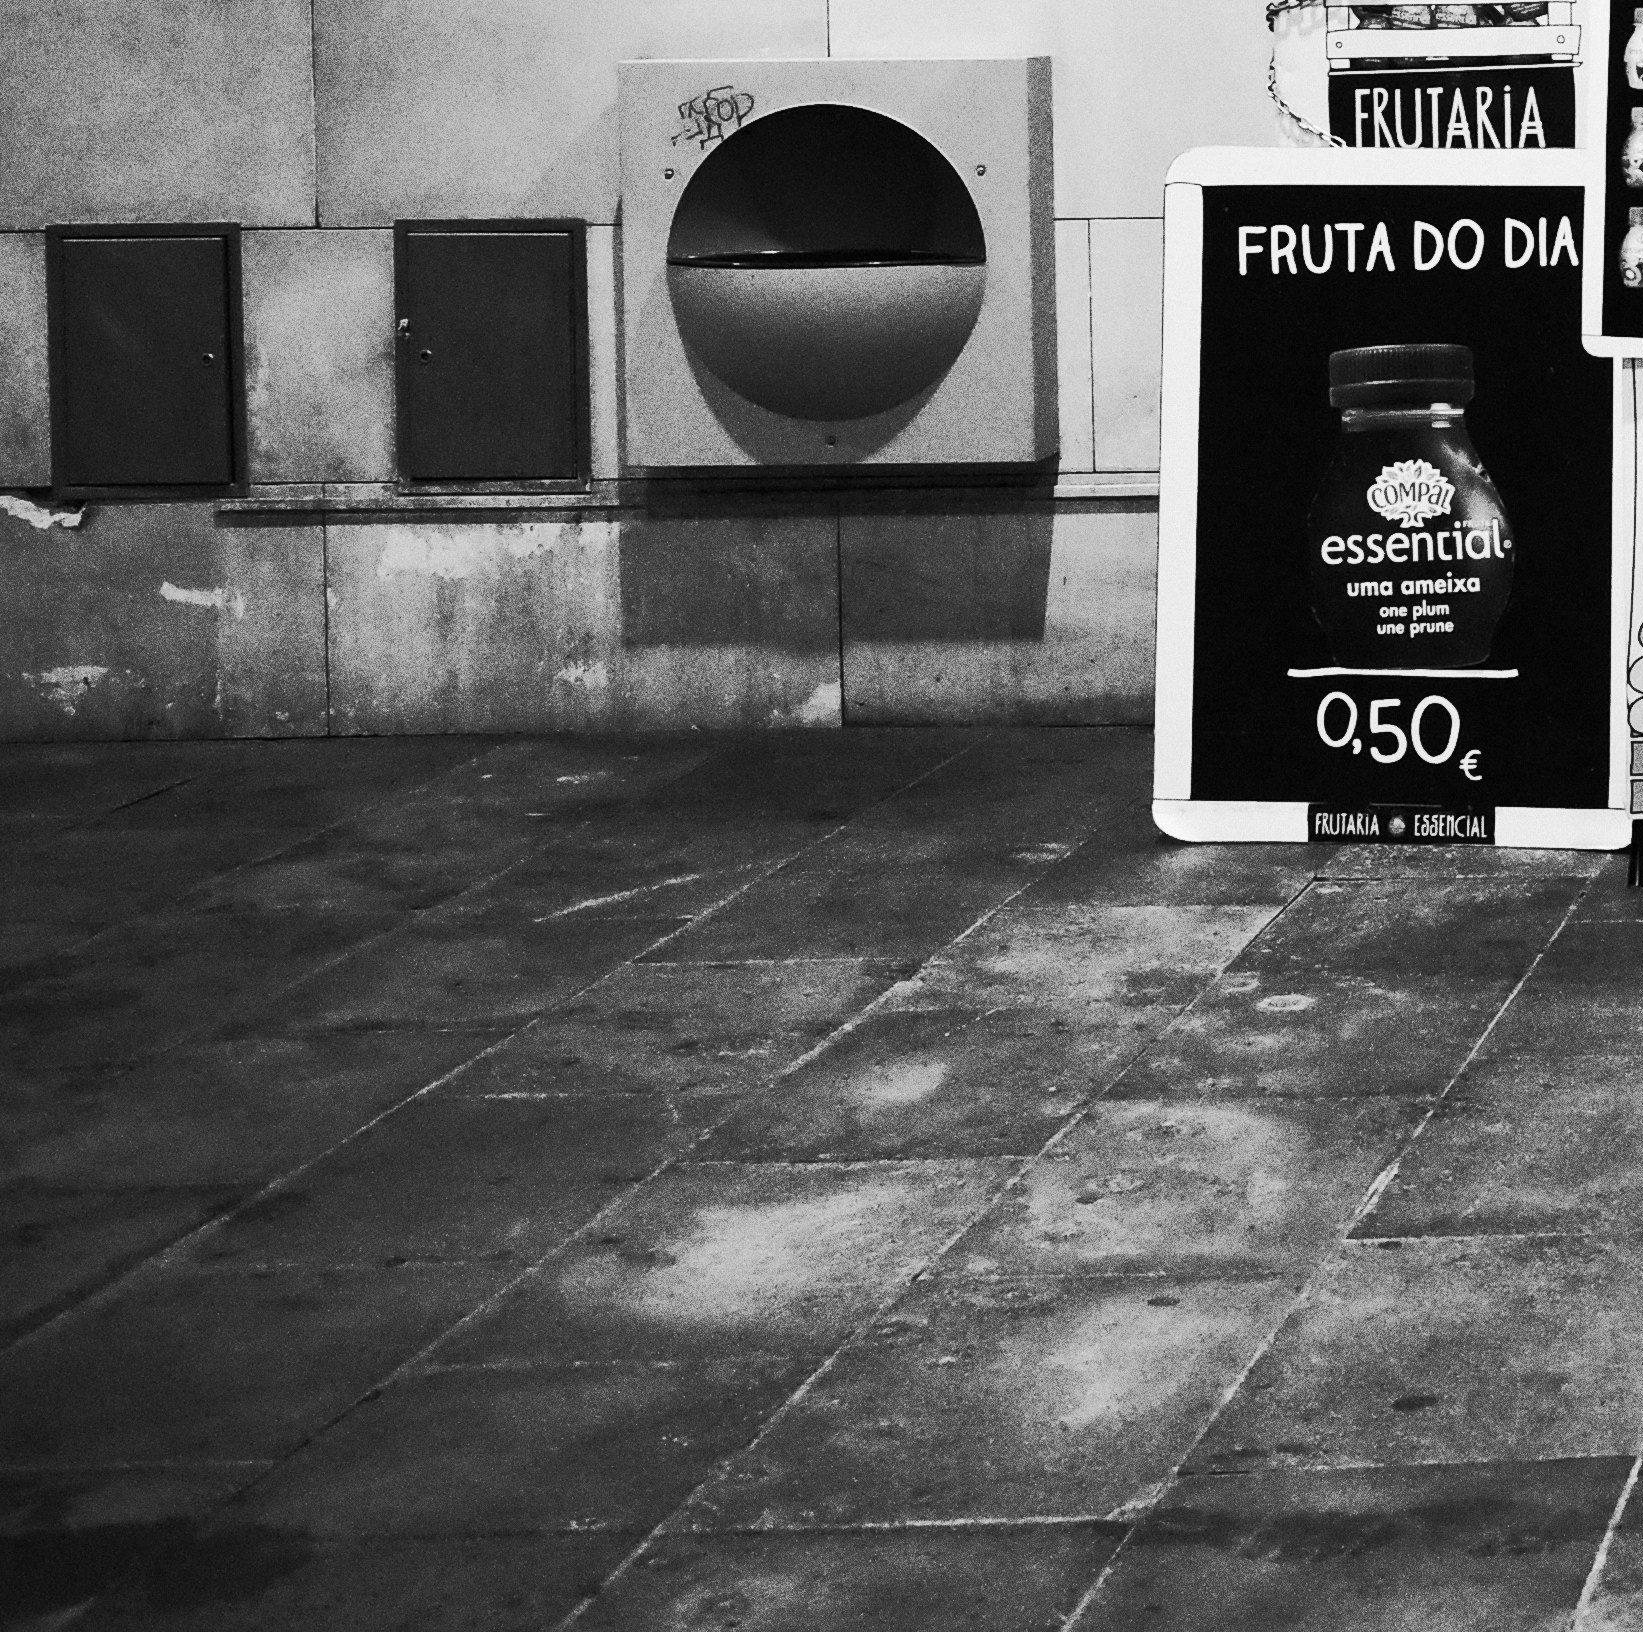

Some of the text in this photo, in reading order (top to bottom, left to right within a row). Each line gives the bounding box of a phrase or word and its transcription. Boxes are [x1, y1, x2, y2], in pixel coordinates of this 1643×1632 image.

[1238, 215, 1581, 276] FRUTA DO DIA
[1321, 520, 1506, 565] essential
[1346, 571, 1481, 598] uma ameixa
[1376, 618, 1455, 639] une prune
[1379, 601, 1450, 621] one plum
[1316, 689, 1484, 782] 0,50€
